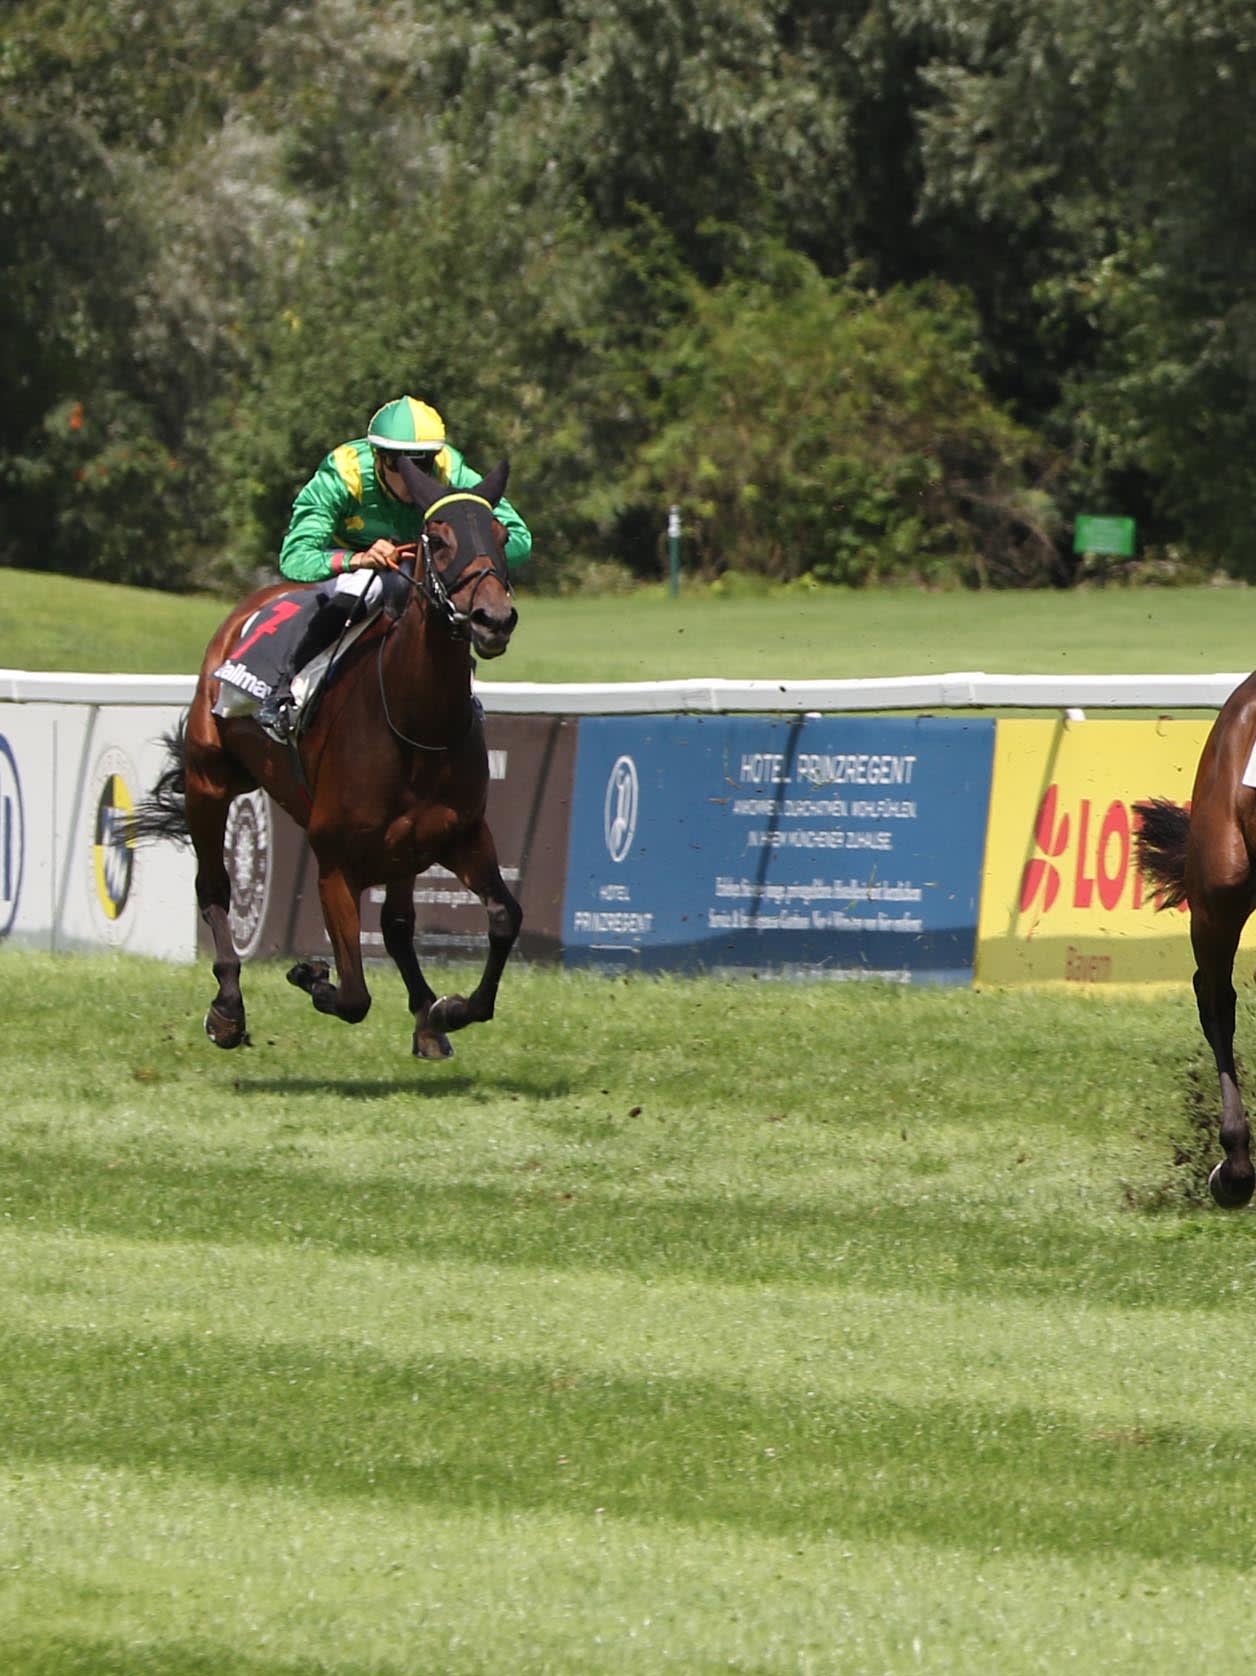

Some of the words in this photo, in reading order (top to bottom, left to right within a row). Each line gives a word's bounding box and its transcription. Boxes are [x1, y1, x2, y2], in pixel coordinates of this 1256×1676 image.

[230, 600, 303, 660] 7
[214, 660, 273, 699] allma
[739, 754, 792, 783] HOTEL
[797, 754, 917, 785] PRINZREGENT
[574, 912, 653, 932] PRINZREGENT
